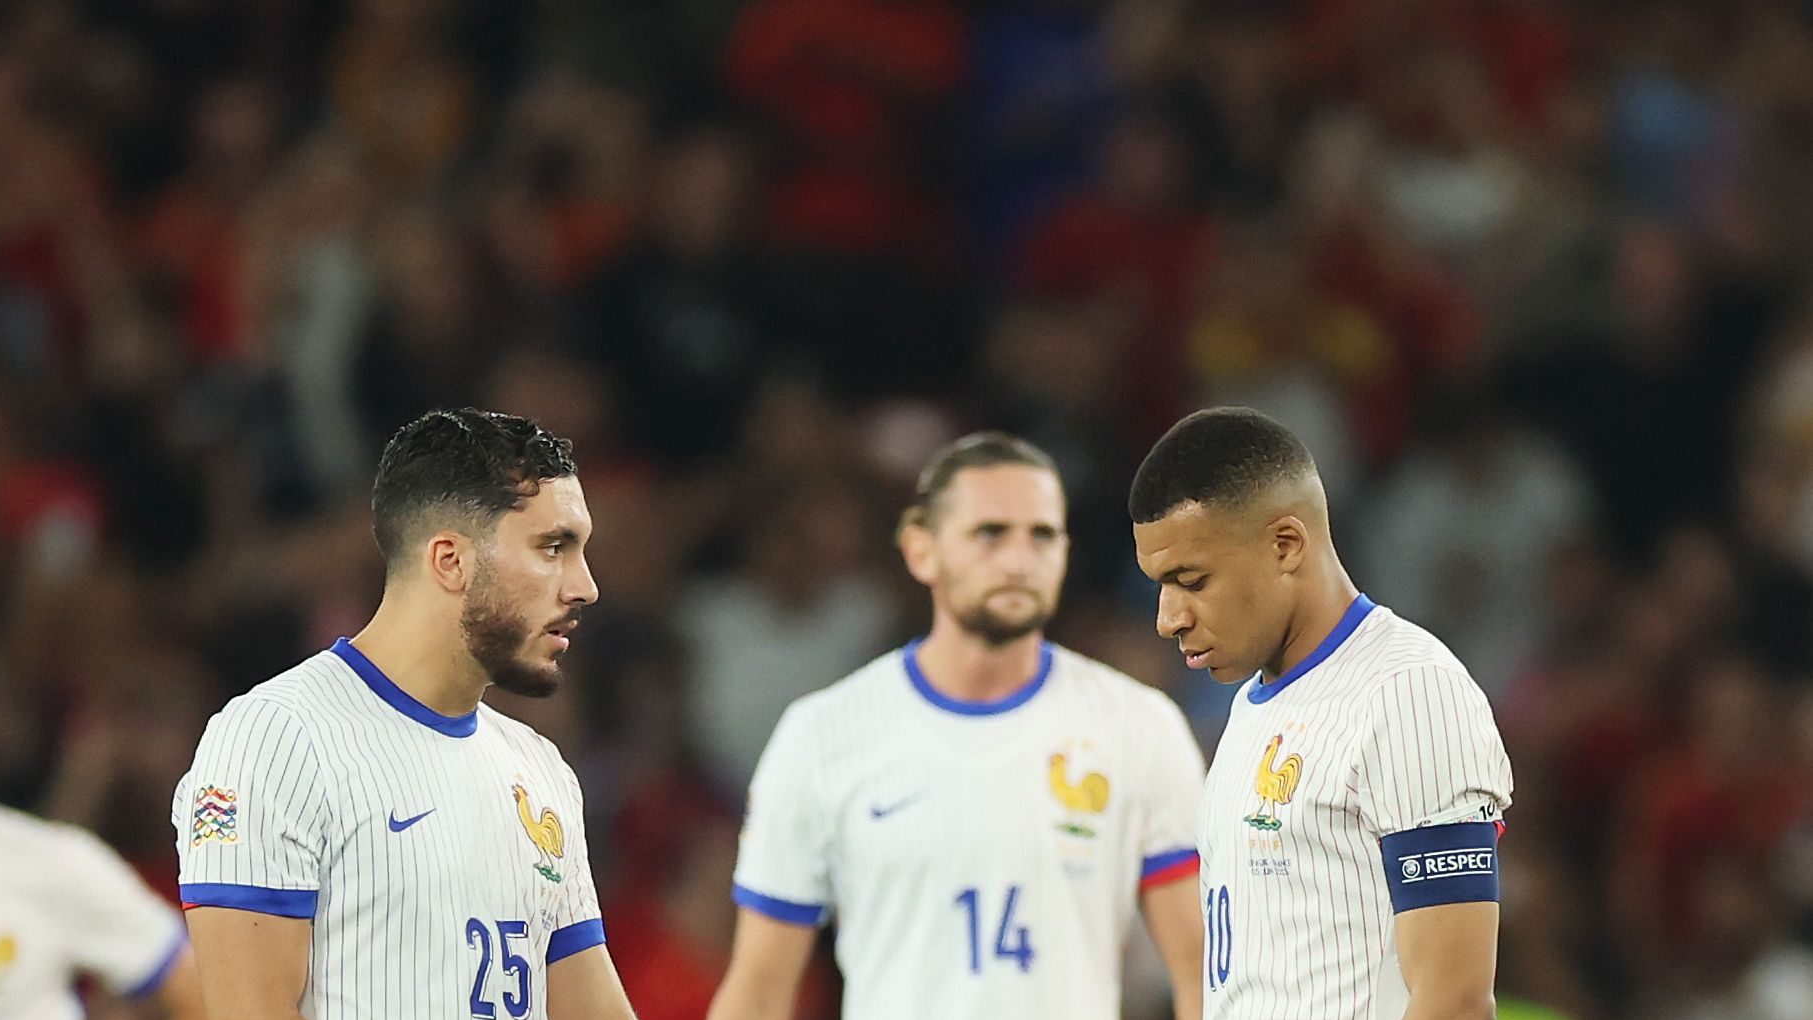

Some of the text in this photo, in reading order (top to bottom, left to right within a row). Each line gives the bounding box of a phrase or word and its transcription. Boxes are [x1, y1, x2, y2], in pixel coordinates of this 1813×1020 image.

[1426, 853, 1492, 873] RESPECT
[953, 885, 1034, 975] 14
[1206, 884, 1232, 992] 10
